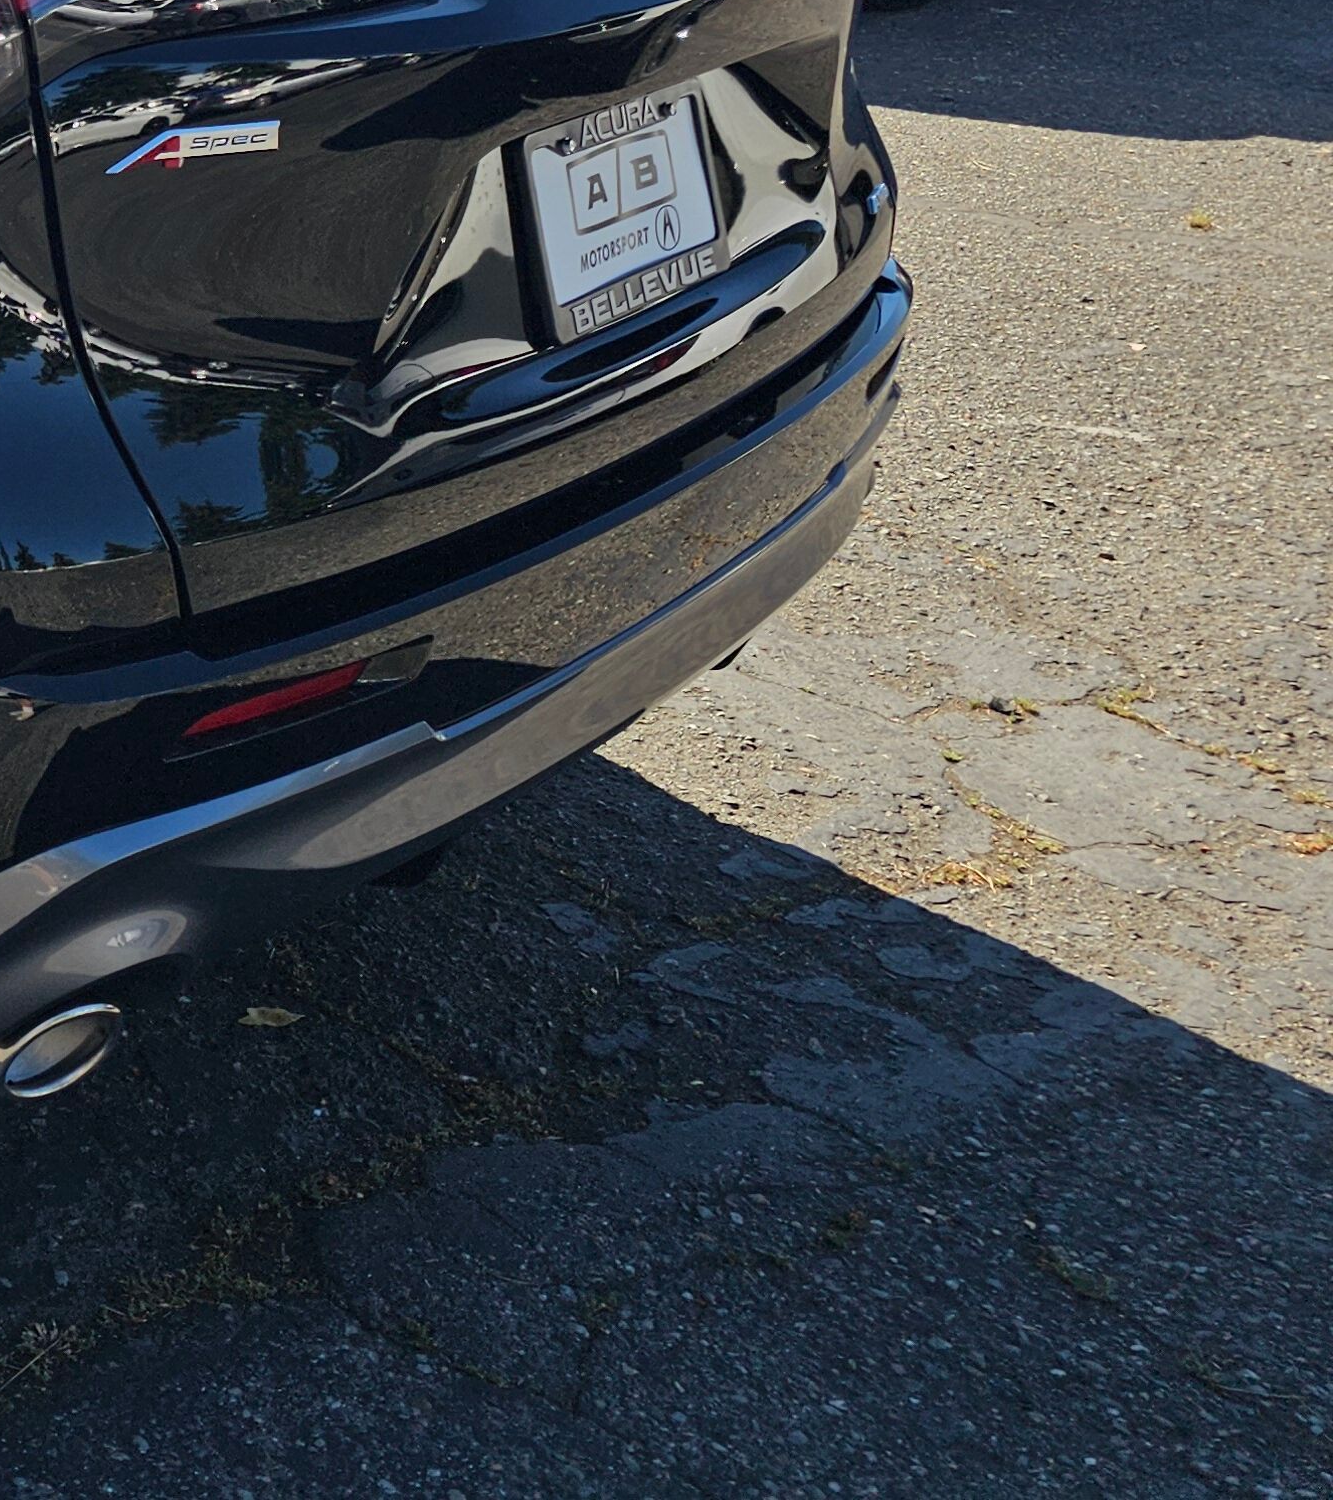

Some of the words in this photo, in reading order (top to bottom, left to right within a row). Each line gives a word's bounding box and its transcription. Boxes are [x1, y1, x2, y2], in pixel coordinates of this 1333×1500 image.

[580, 95, 660, 148] ACURA
[587, 173, 609, 211] A
[629, 154, 659, 191] B
[580, 226, 650, 274] MOTORSPORT
[569, 246, 718, 335] BELLEVUE
